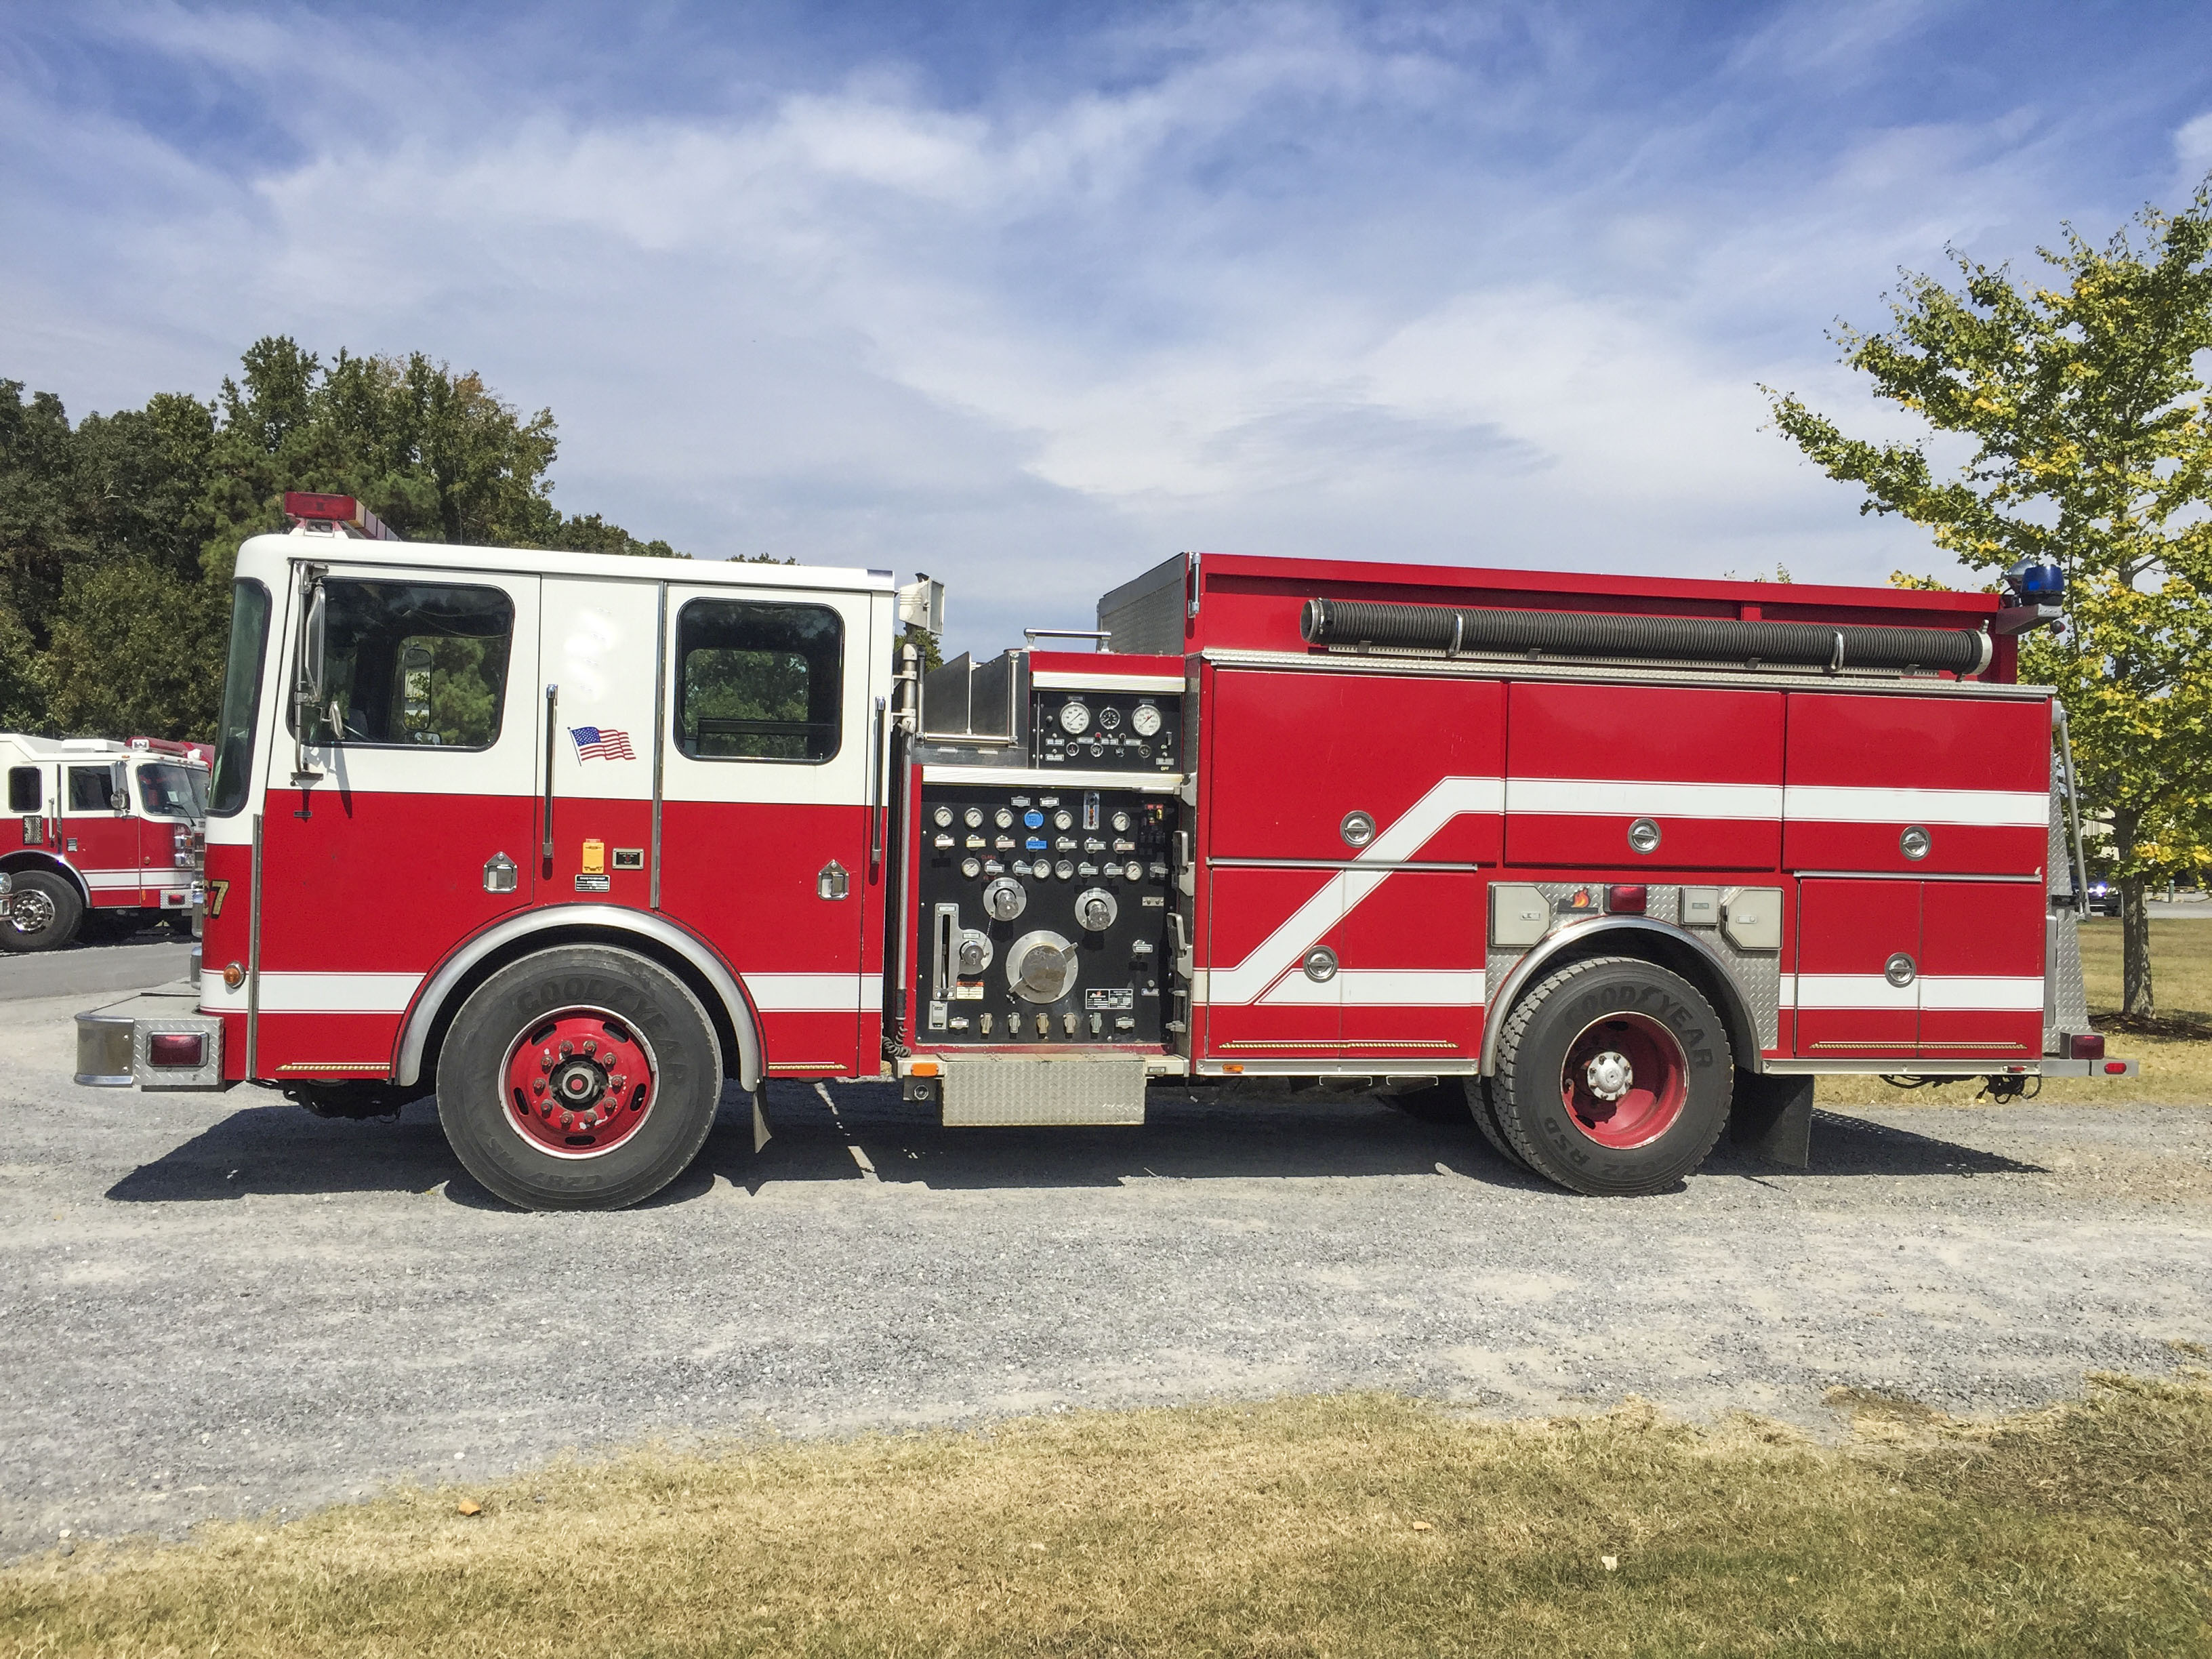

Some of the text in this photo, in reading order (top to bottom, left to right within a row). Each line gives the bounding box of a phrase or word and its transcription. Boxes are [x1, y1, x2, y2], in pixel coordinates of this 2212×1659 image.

[203, 878, 229, 918] 7
[516, 978, 687, 1084] GOODYEAR
[1565, 985, 1713, 1069] GOODYEAR
